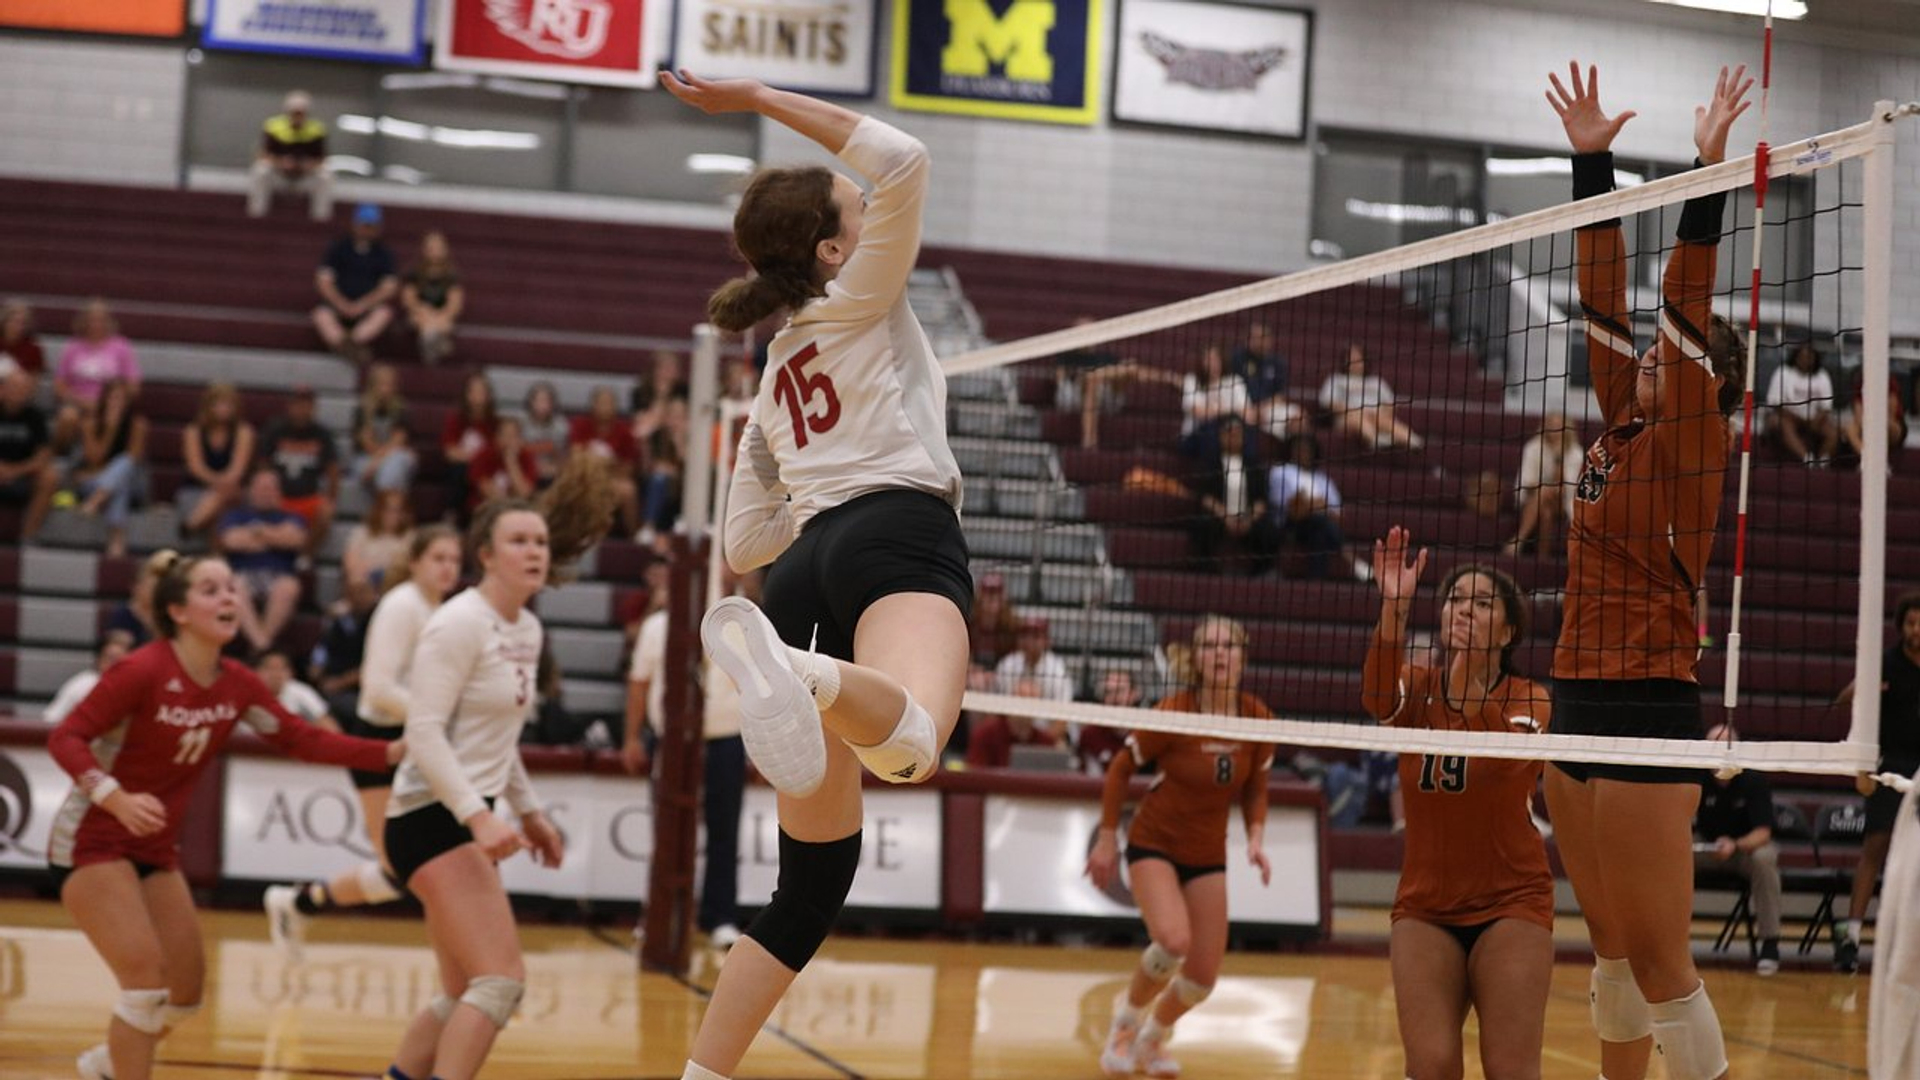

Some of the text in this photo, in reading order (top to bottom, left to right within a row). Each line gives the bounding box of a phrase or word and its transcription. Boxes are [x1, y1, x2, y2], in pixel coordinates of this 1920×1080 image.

[702, 10, 848, 64] SAINTS
[941, 0, 1056, 82] M
[773, 341, 841, 450] 15
[1215, 753, 1233, 785] 8
[1418, 753, 1467, 793] 19
